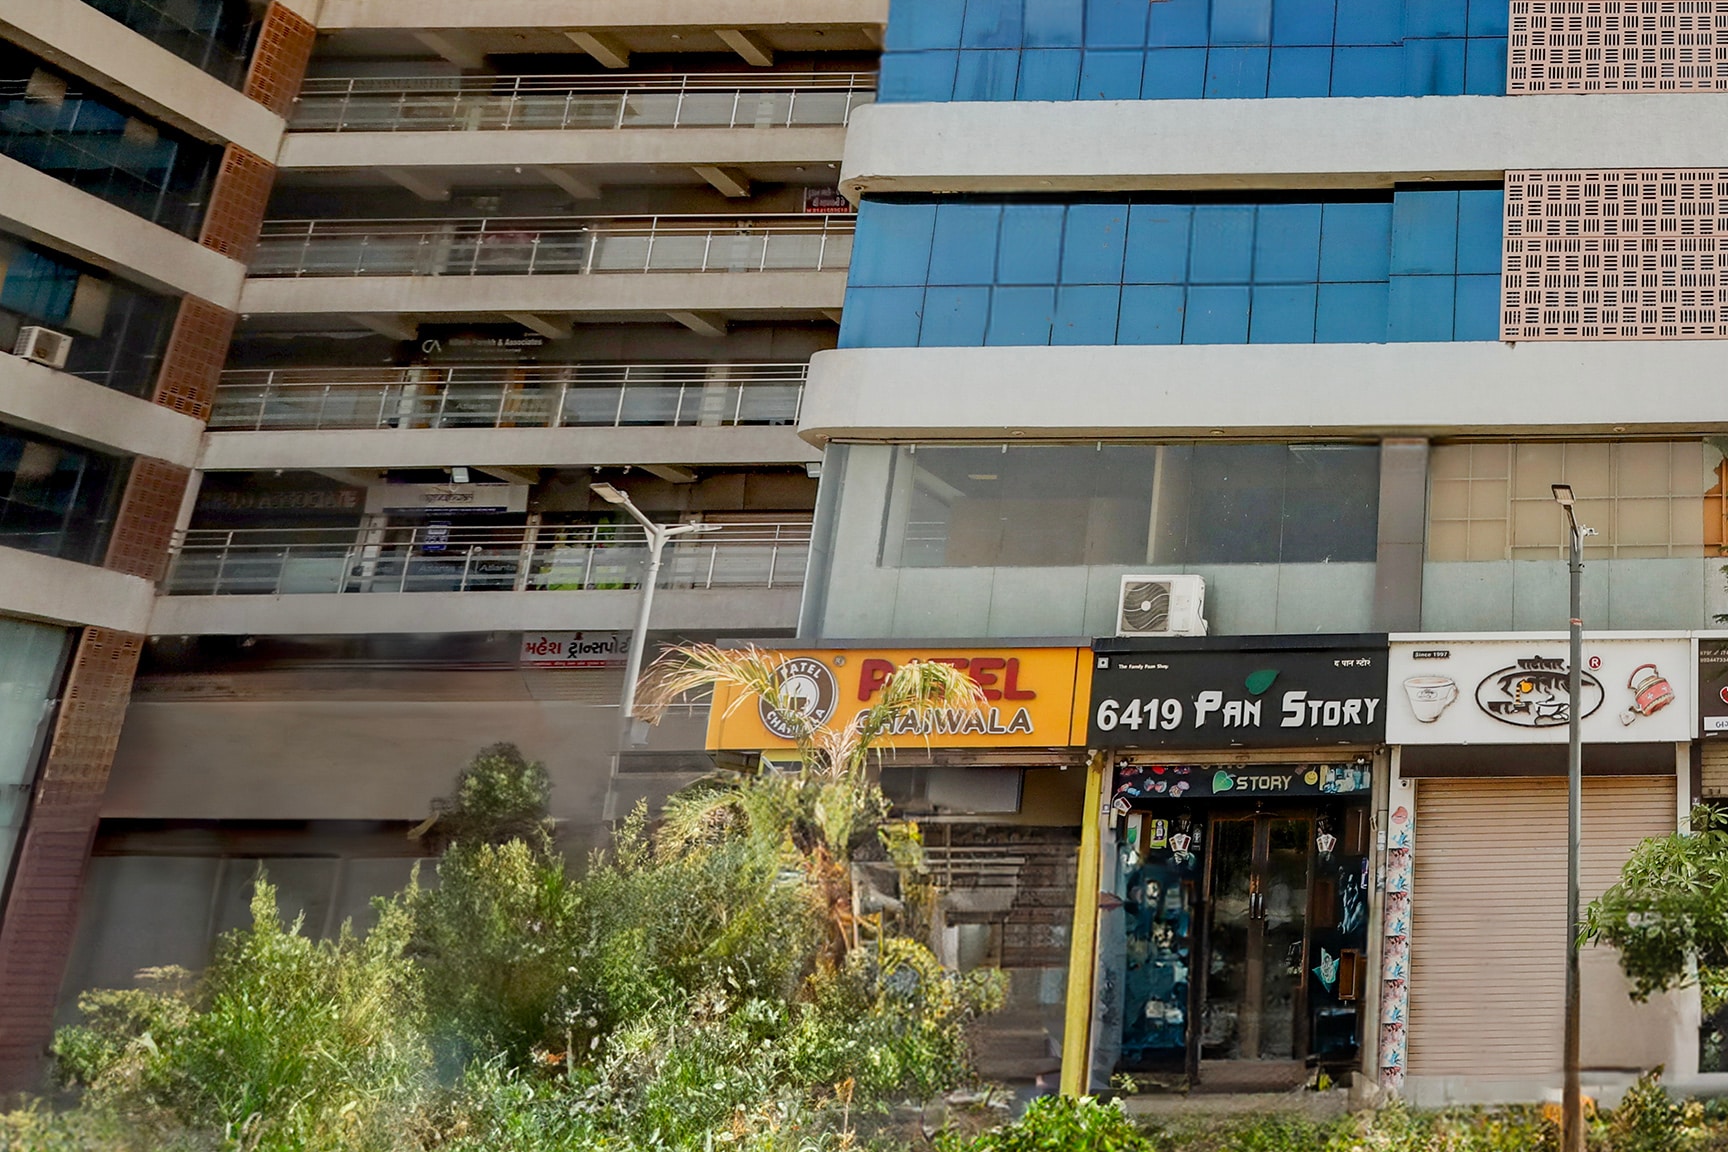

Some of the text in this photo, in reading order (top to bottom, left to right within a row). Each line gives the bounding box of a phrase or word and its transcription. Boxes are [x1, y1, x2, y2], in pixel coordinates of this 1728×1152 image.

[780, 662, 823, 680] PATEL
[1096, 698, 1184, 732] 6419
[1235, 775, 1293, 791] STORY
